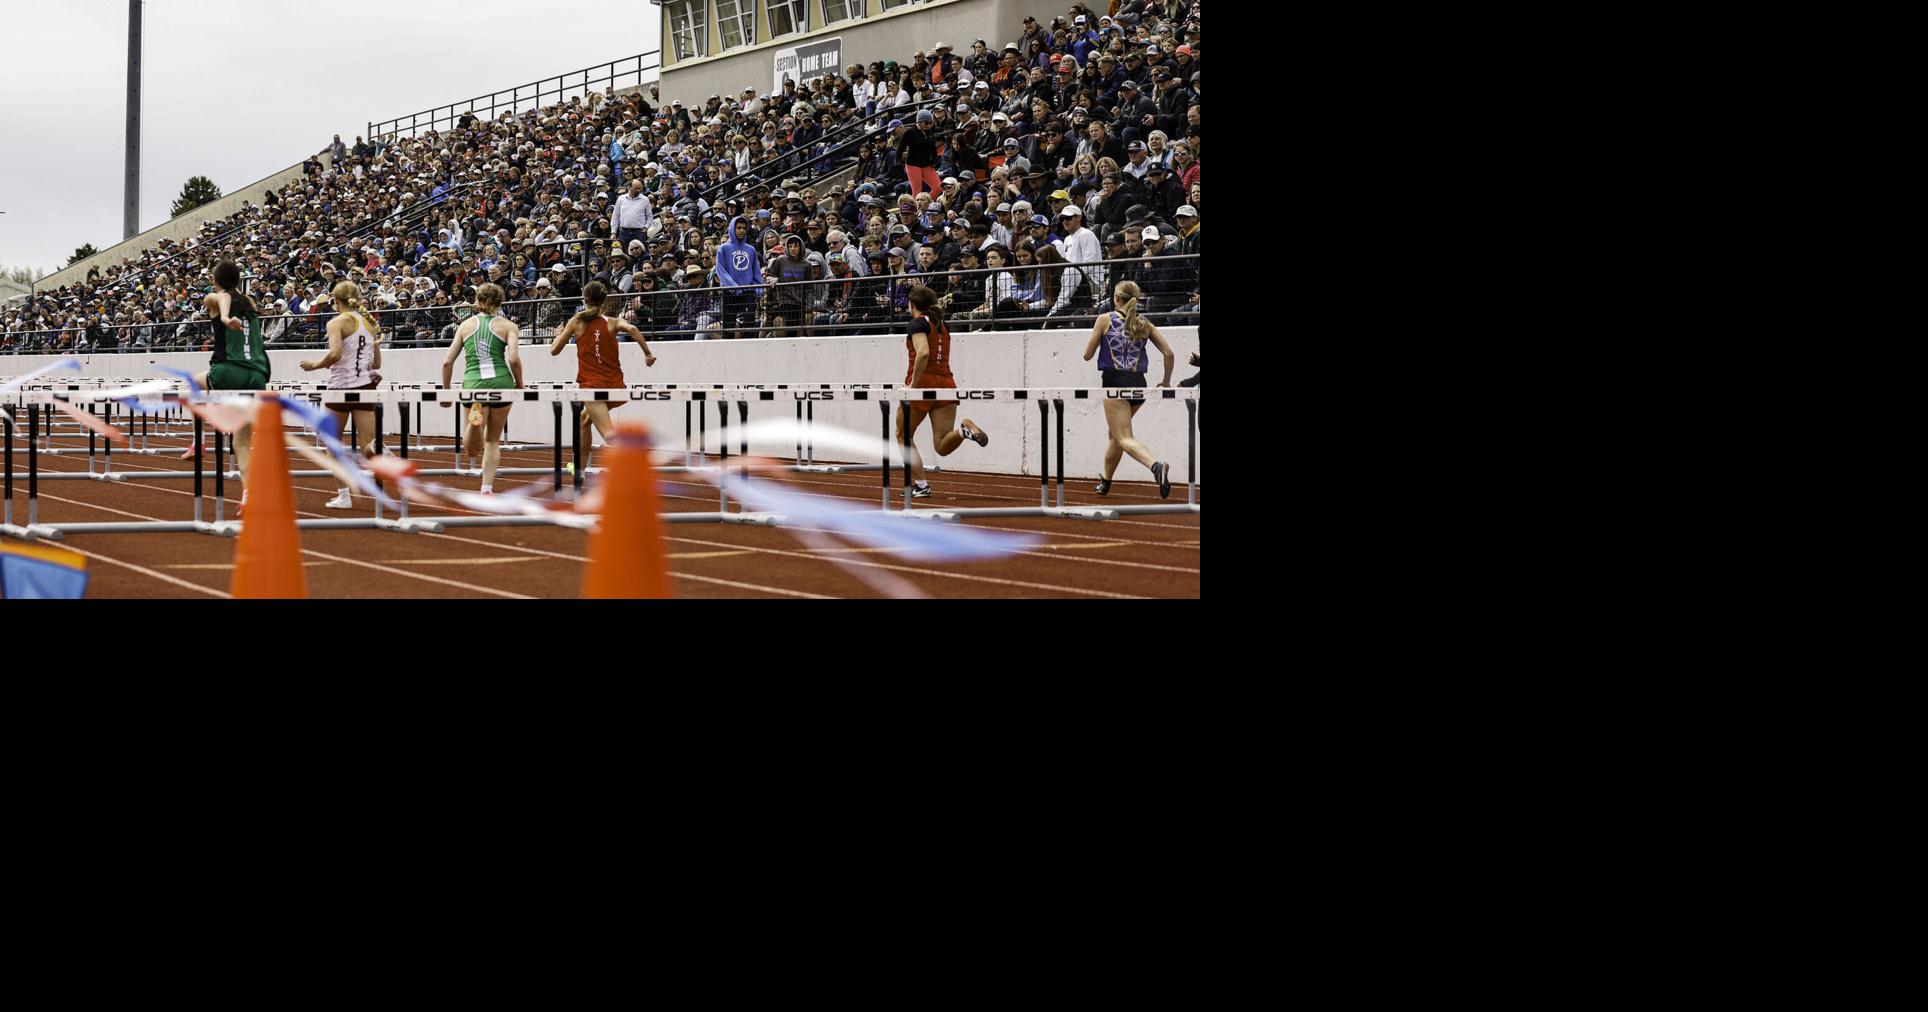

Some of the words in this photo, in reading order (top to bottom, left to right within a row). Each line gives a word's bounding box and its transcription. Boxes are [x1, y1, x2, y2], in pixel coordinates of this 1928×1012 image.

[776, 55, 797, 72] SECTION
[802, 54, 819, 73] HOME
[821, 50, 839, 69] TEAM
[459, 391, 502, 401] UCS
[629, 391, 671, 401] UCS
[794, 391, 834, 401] UCS
[955, 390, 995, 400] UCS
[1106, 390, 1144, 400] UCS
